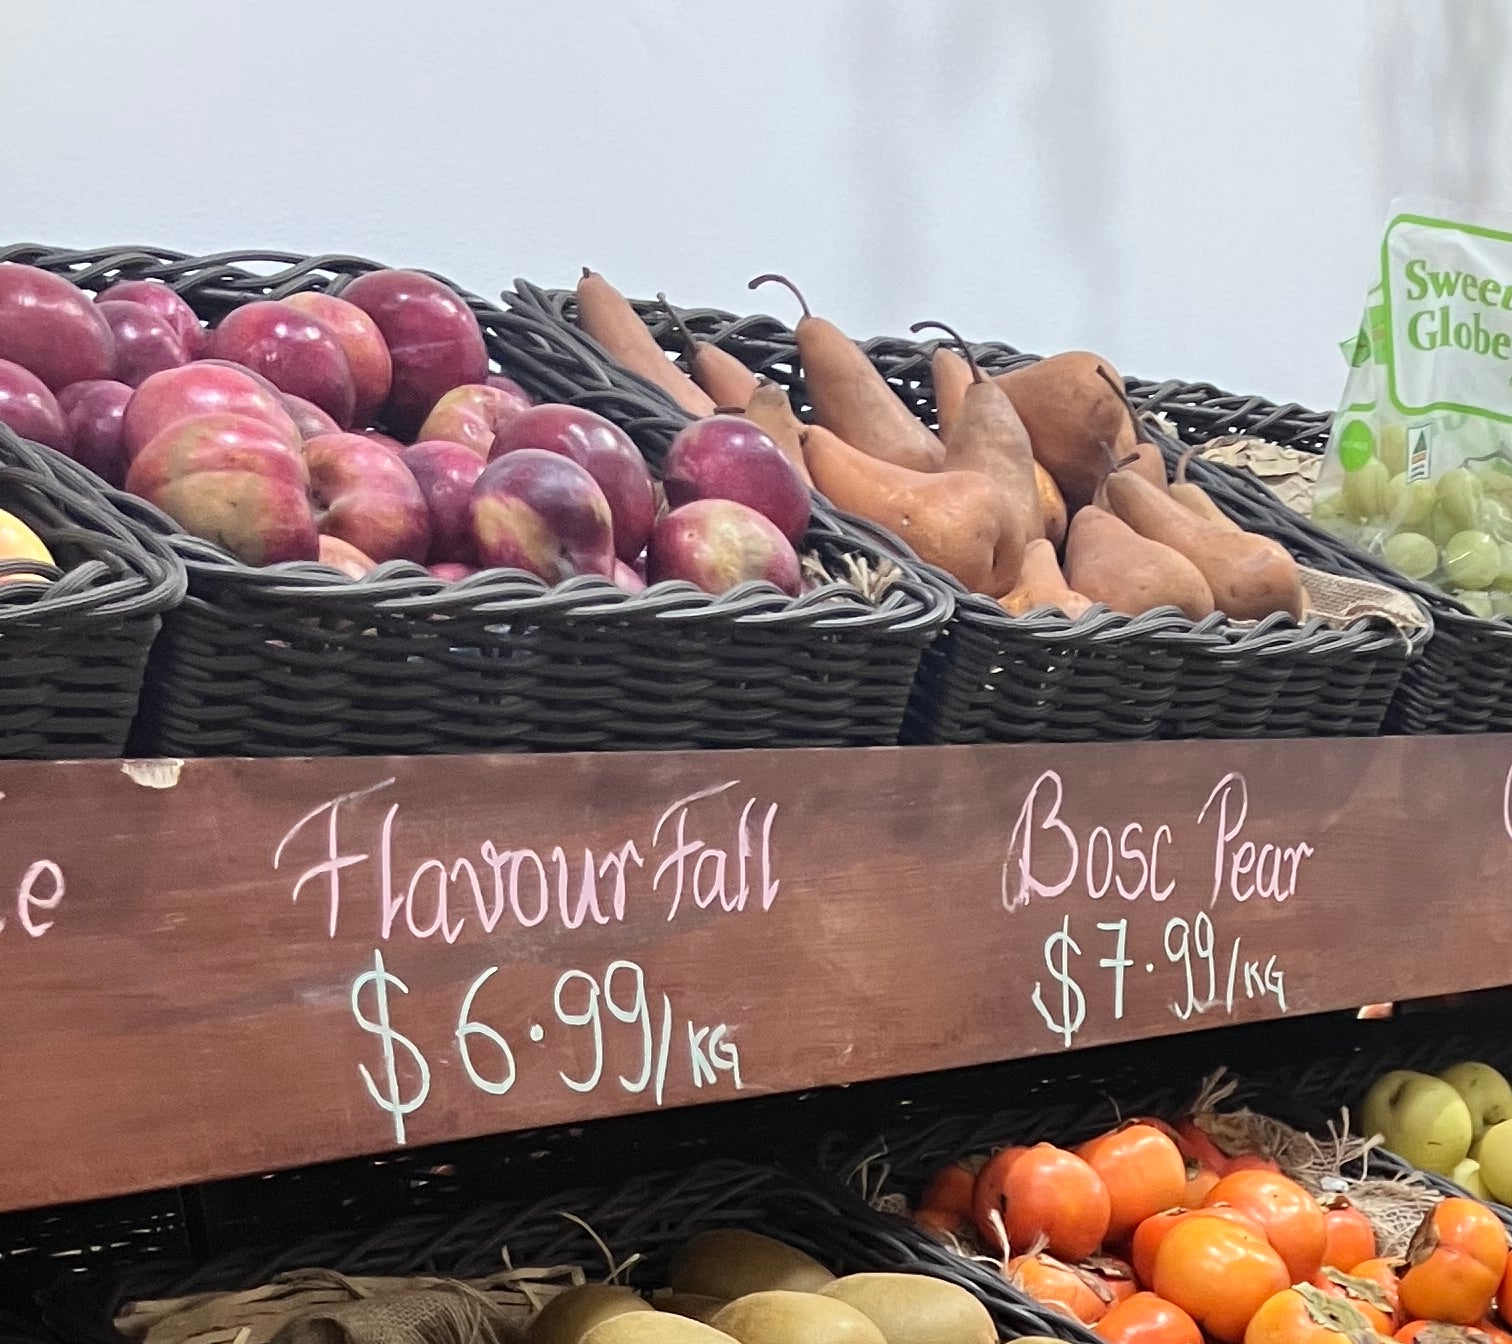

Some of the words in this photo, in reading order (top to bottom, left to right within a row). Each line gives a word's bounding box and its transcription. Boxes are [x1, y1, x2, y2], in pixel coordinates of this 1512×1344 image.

[1407, 306, 1512, 360] Globe
[274, 777, 644, 943] Flavour
[652, 779, 779, 922] Fall
[1003, 770, 1176, 914] Bosc
[1199, 771, 1315, 908] Pear
[1031, 911, 1287, 1049] $7.99/KG
